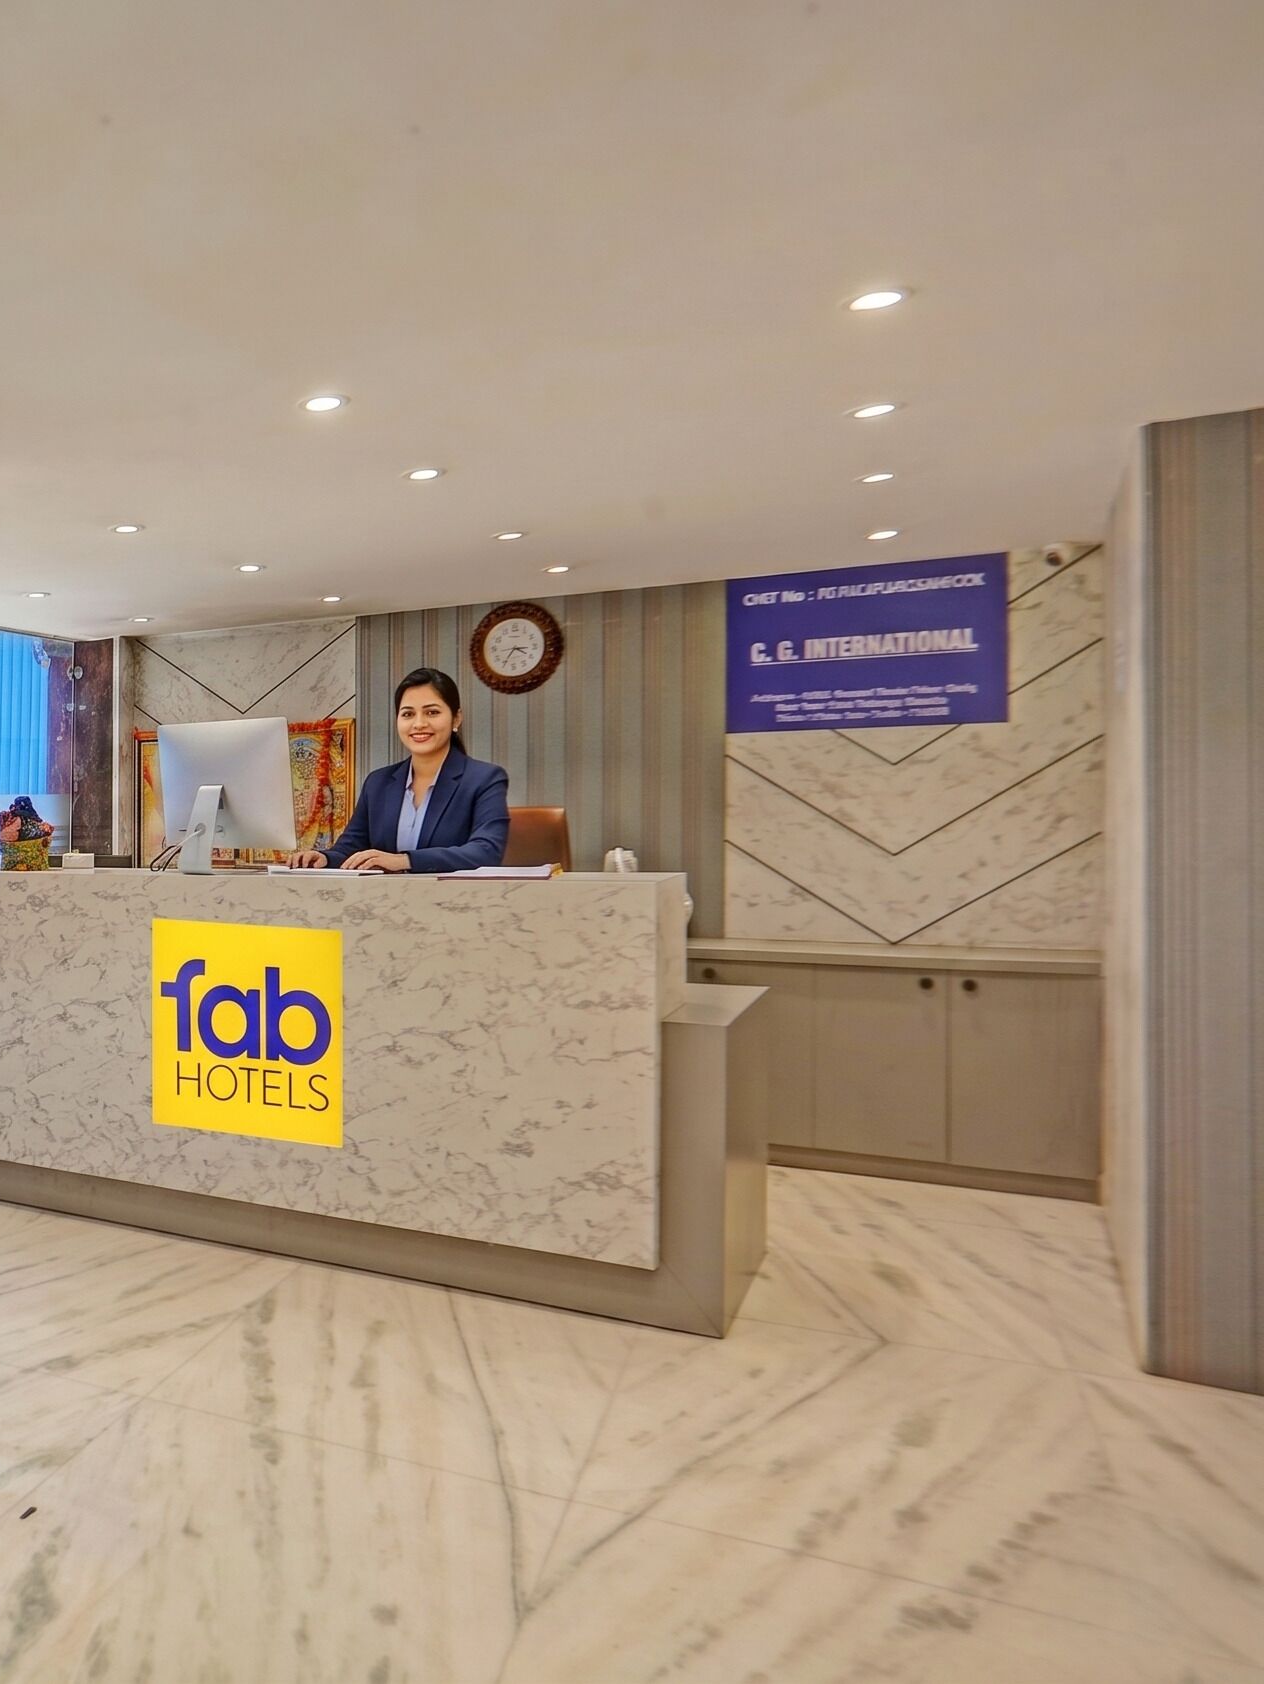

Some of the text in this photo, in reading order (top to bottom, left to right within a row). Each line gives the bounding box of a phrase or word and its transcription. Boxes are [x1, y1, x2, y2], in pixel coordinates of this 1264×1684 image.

[803, 627, 979, 660] INTERNATIONAL
[160, 958, 332, 1066] fab
[176, 1060, 330, 1112] HOTELS
